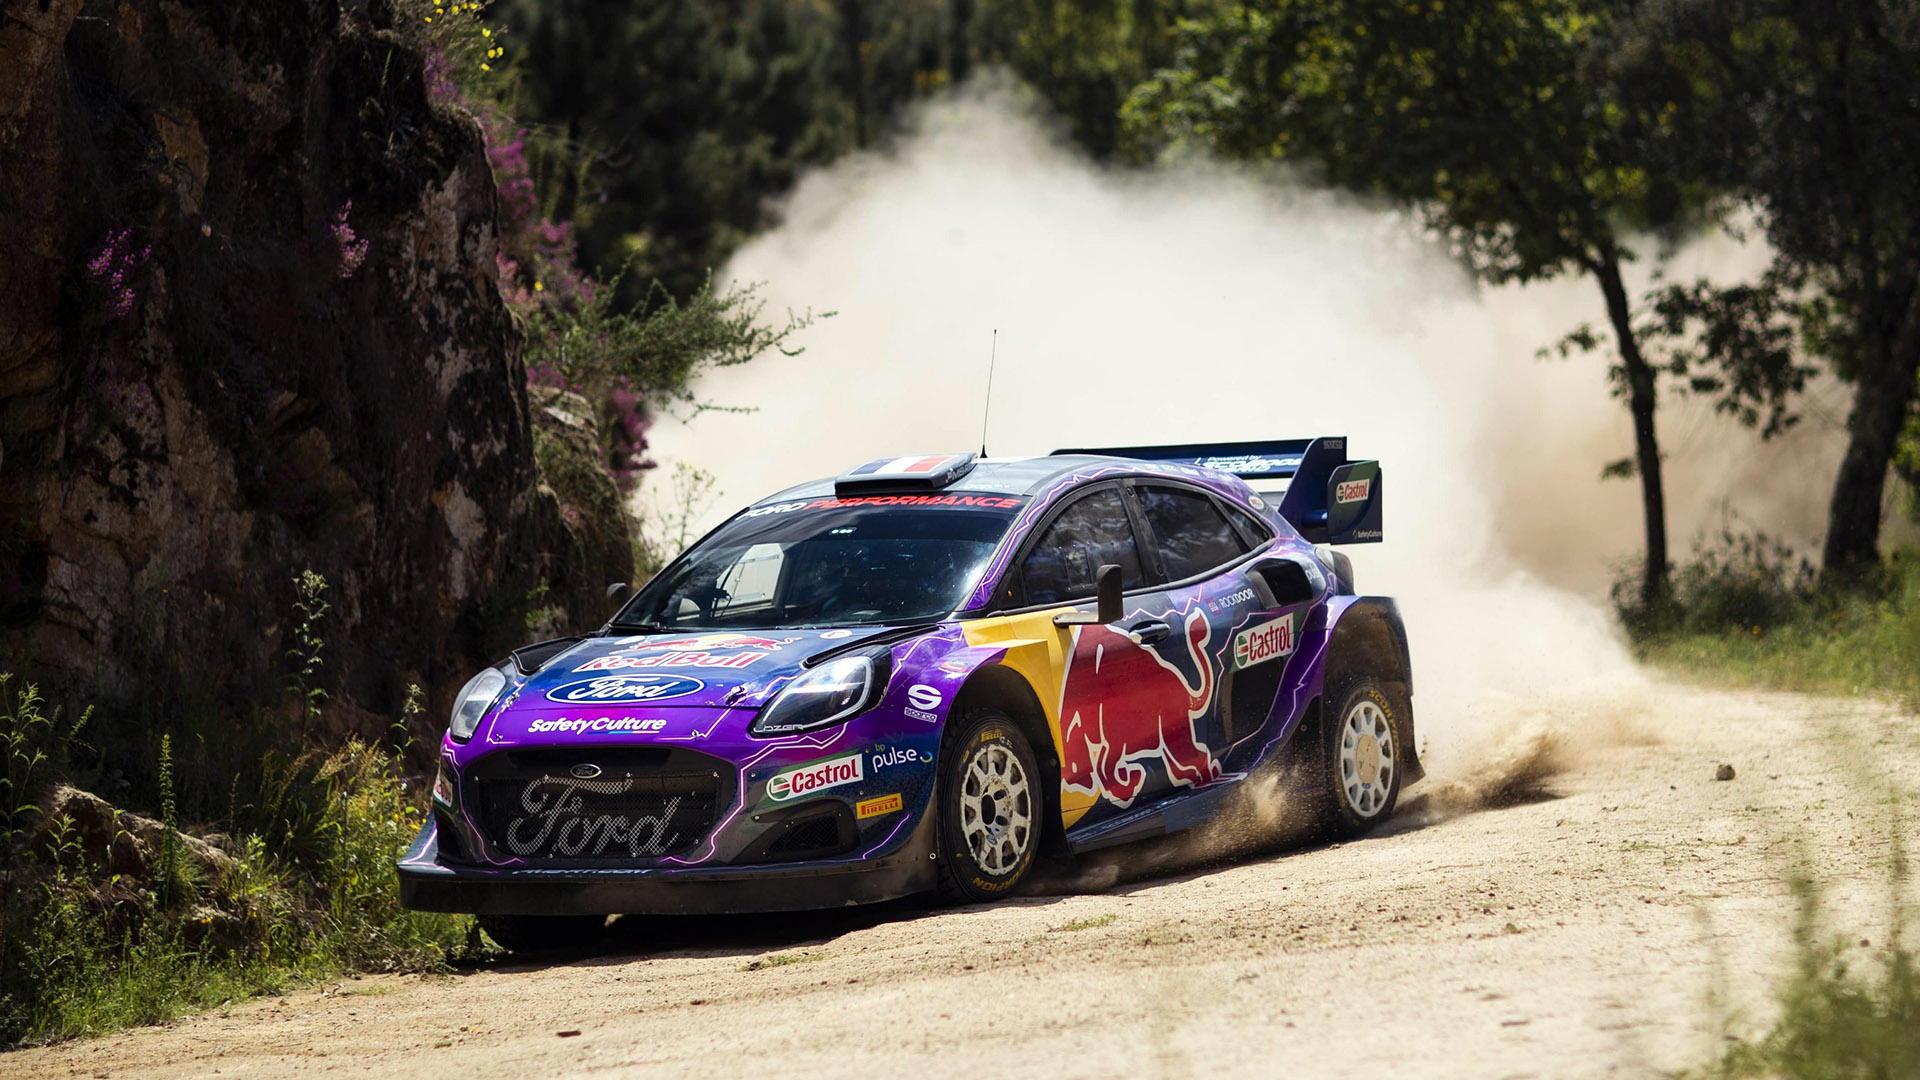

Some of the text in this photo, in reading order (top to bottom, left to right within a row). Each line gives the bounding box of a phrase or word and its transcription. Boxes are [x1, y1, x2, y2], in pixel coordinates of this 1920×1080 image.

[1344, 481, 1368, 501] Castrol
[803, 495, 1022, 510] PERFORMANCE
[1219, 588, 1255, 608] ROCKDOOR
[1249, 617, 1292, 664] Castrol
[571, 651, 769, 672] Red Bull
[567, 675, 681, 699] Ford
[904, 707, 937, 723] sparco
[527, 716, 667, 735] SafetyCulture
[875, 743, 886, 752] bp
[872, 747, 917, 773] pulse
[792, 758, 859, 794] Castrol
[506, 776, 682, 856] Ford
[861, 797, 899, 815] PIRELLI
